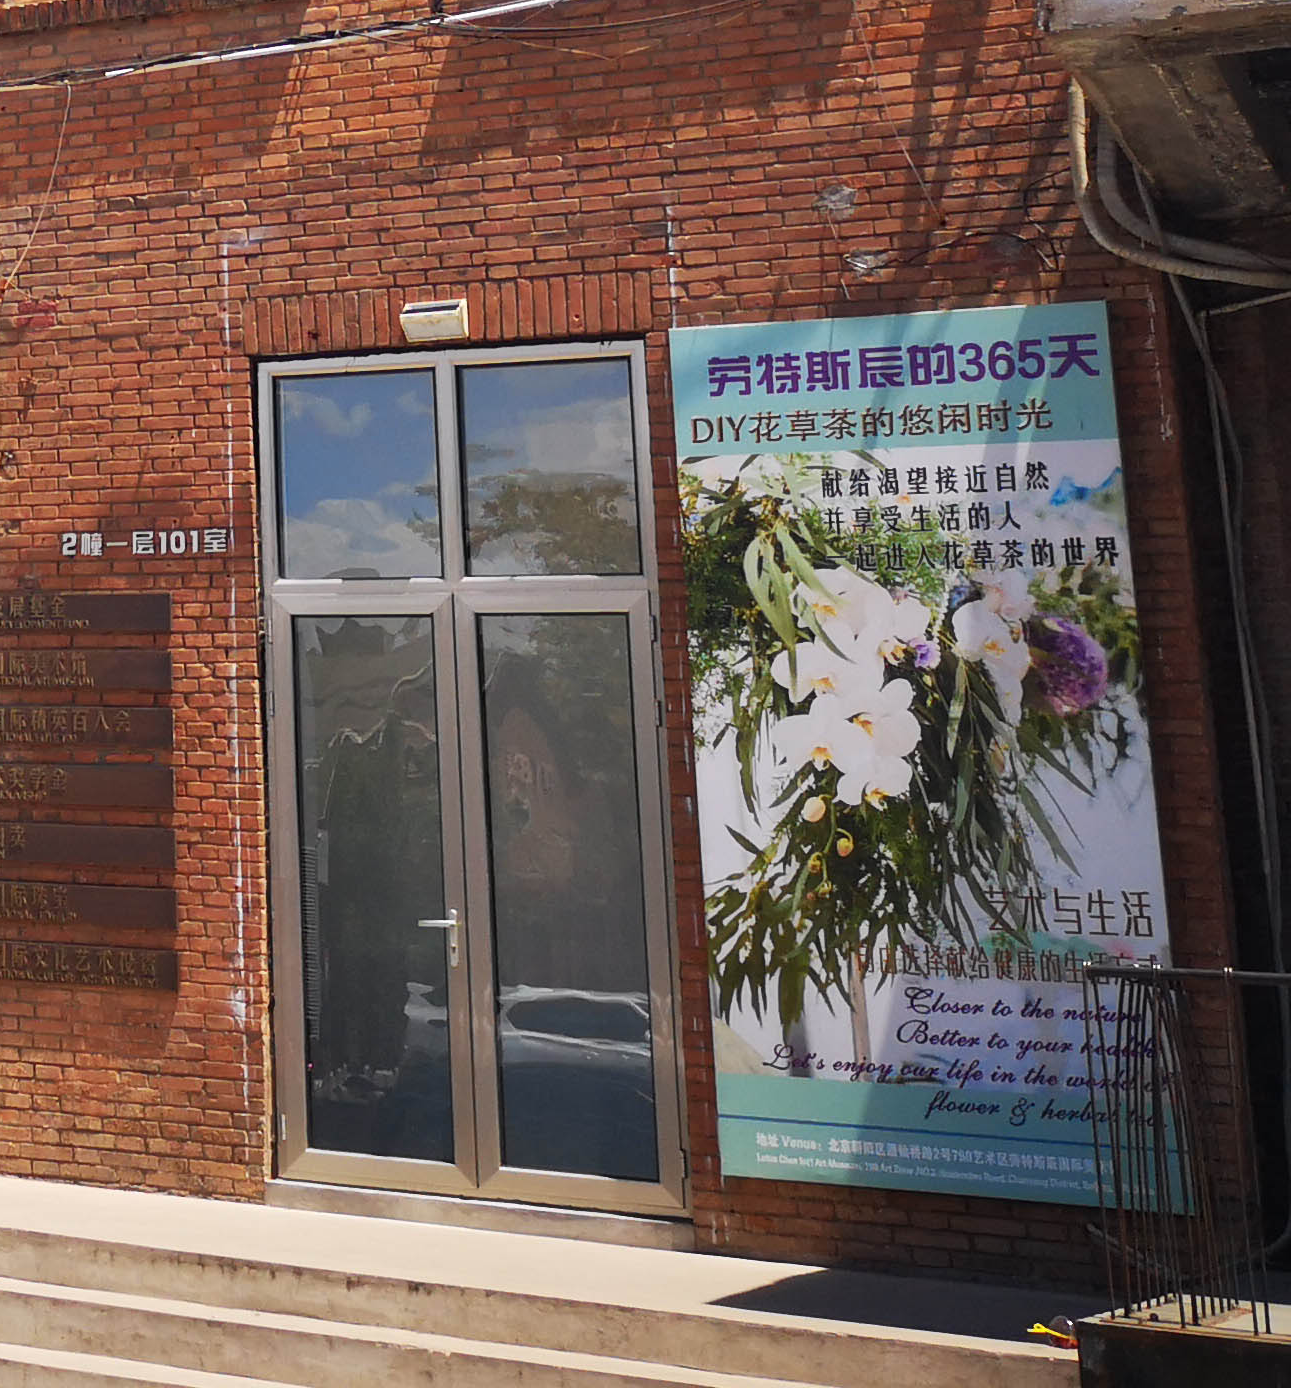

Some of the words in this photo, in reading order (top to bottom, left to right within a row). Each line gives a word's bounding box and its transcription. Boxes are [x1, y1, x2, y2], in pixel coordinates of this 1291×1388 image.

[707, 332, 1100, 398] 劳特斯辰的365天
[690, 400, 1054, 445] DIY花草茶的悠闲时光
[820, 461, 1050, 499] 献给渴望接近自然
[823, 502, 1022, 534] 并享受生活的人
[62, 527, 228, 558] 2幢一层101室
[826, 537, 1121, 574] 一起进入花草茶的世界
[985, 886, 1155, 938] 艺术与生活
[904, 986, 985, 1015] Closer
[991, 998, 1013, 1017] to
[1020, 997, 1055, 1020] the
[896, 1019, 981, 1047] Better
[986, 1032, 1010, 1050] to
[1015, 1038, 1073, 1060] your
[762, 1043, 825, 1071] Let's
[832, 1056, 894, 1084] enjoy
[899, 1062, 940, 1078] our
[946, 1058, 984, 1089] life
[990, 1065, 1016, 1085] in
[1024, 1064, 1059, 1087] the
[924, 1090, 1002, 1120] flower
